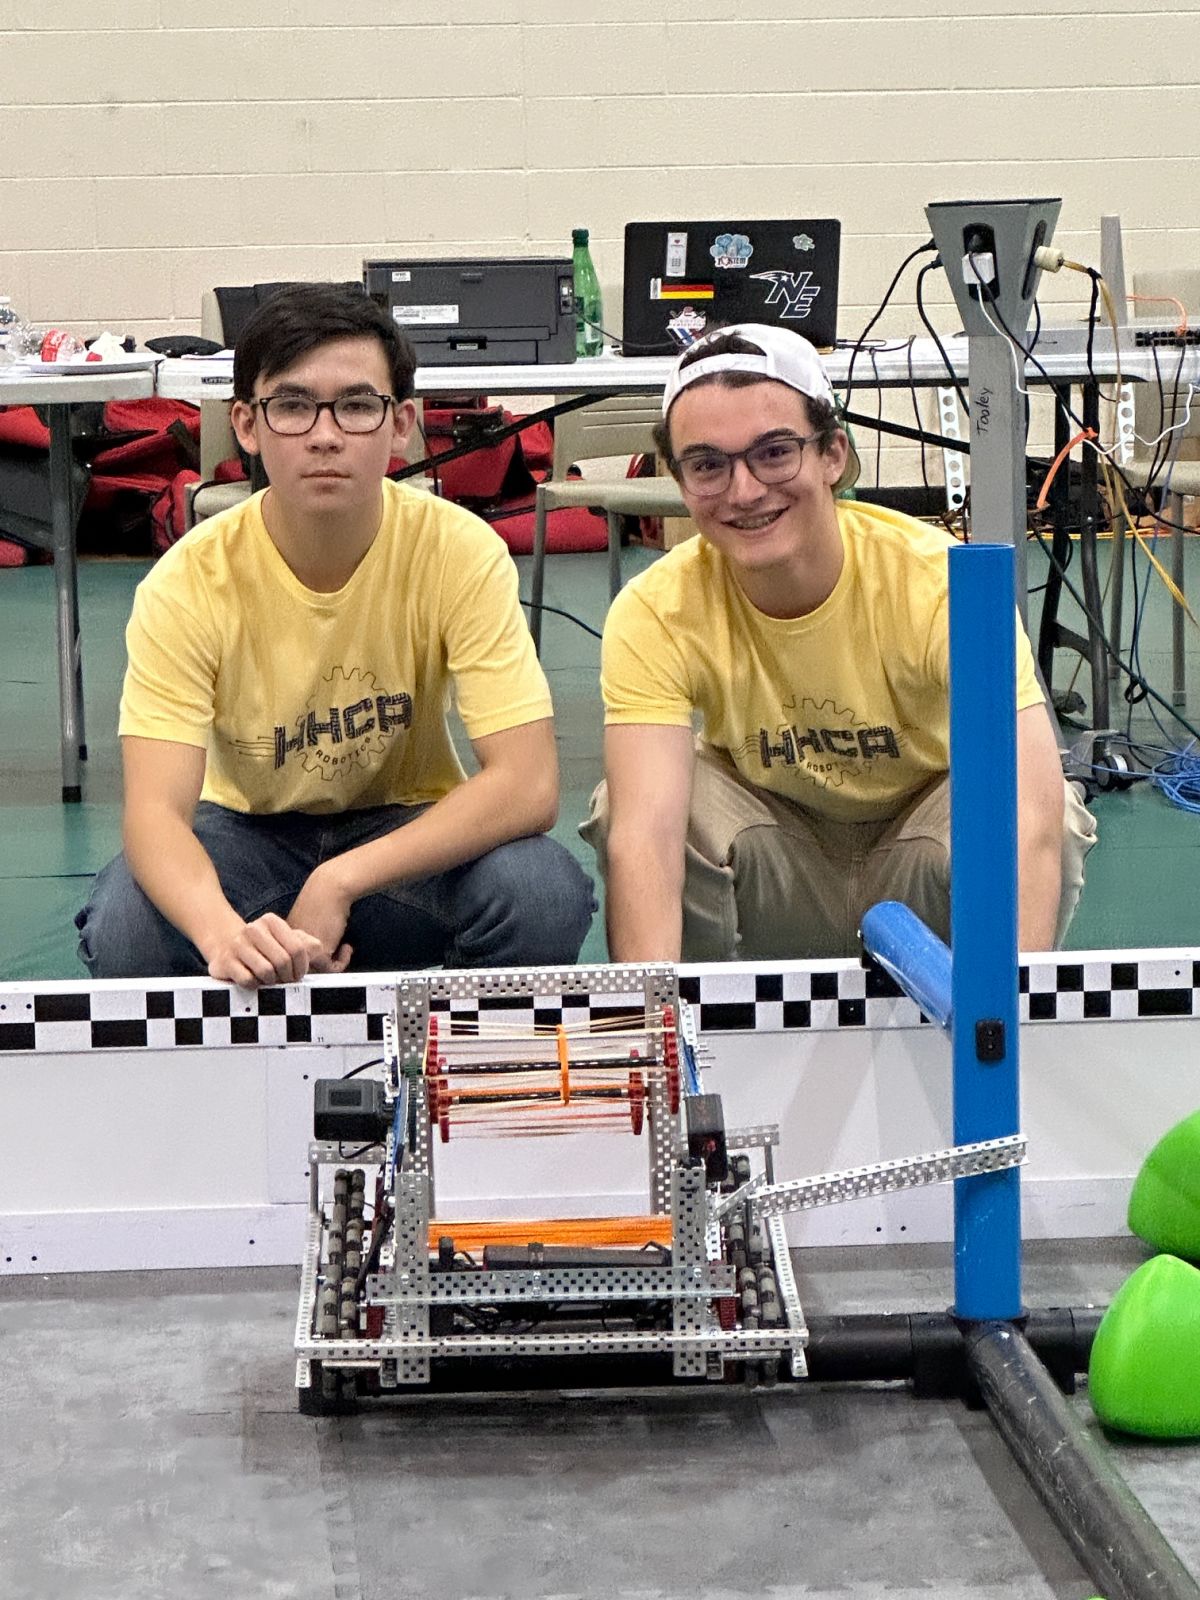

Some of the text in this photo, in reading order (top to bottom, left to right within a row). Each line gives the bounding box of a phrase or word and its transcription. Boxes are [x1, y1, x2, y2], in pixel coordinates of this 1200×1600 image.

[764, 270, 821, 319] NE
[974, 387, 994, 436] Tooley
[274, 692, 412, 770] HHCA
[315, 736, 371, 765] ROBOTICS
[760, 725, 900, 768] HHCA
